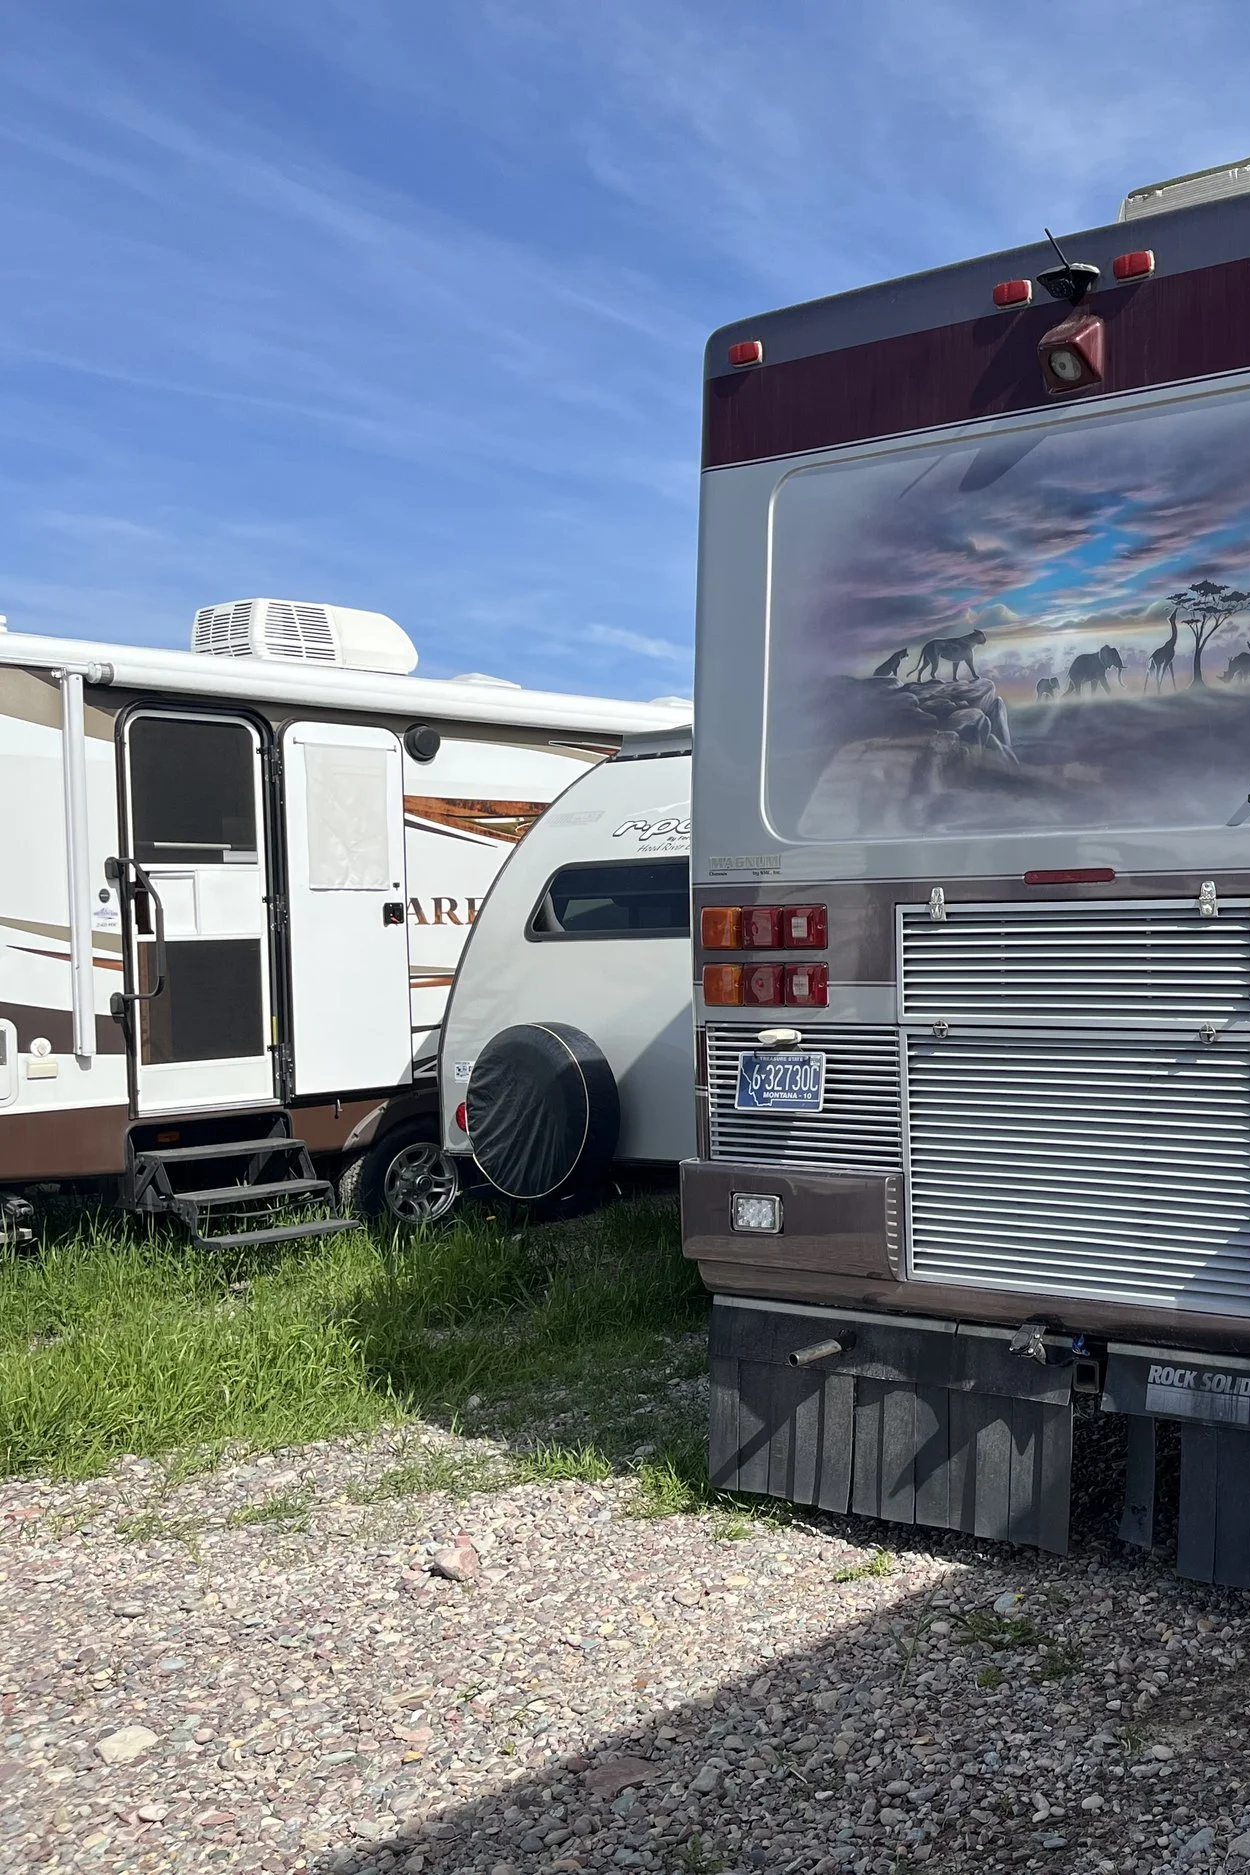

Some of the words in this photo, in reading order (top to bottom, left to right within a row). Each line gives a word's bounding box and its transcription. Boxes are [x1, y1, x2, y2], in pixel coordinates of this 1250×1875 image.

[709, 854, 782, 869] MAGNUM
[763, 1091, 797, 1099] MONTANA
[1147, 1364, 1198, 1388] ROCK
